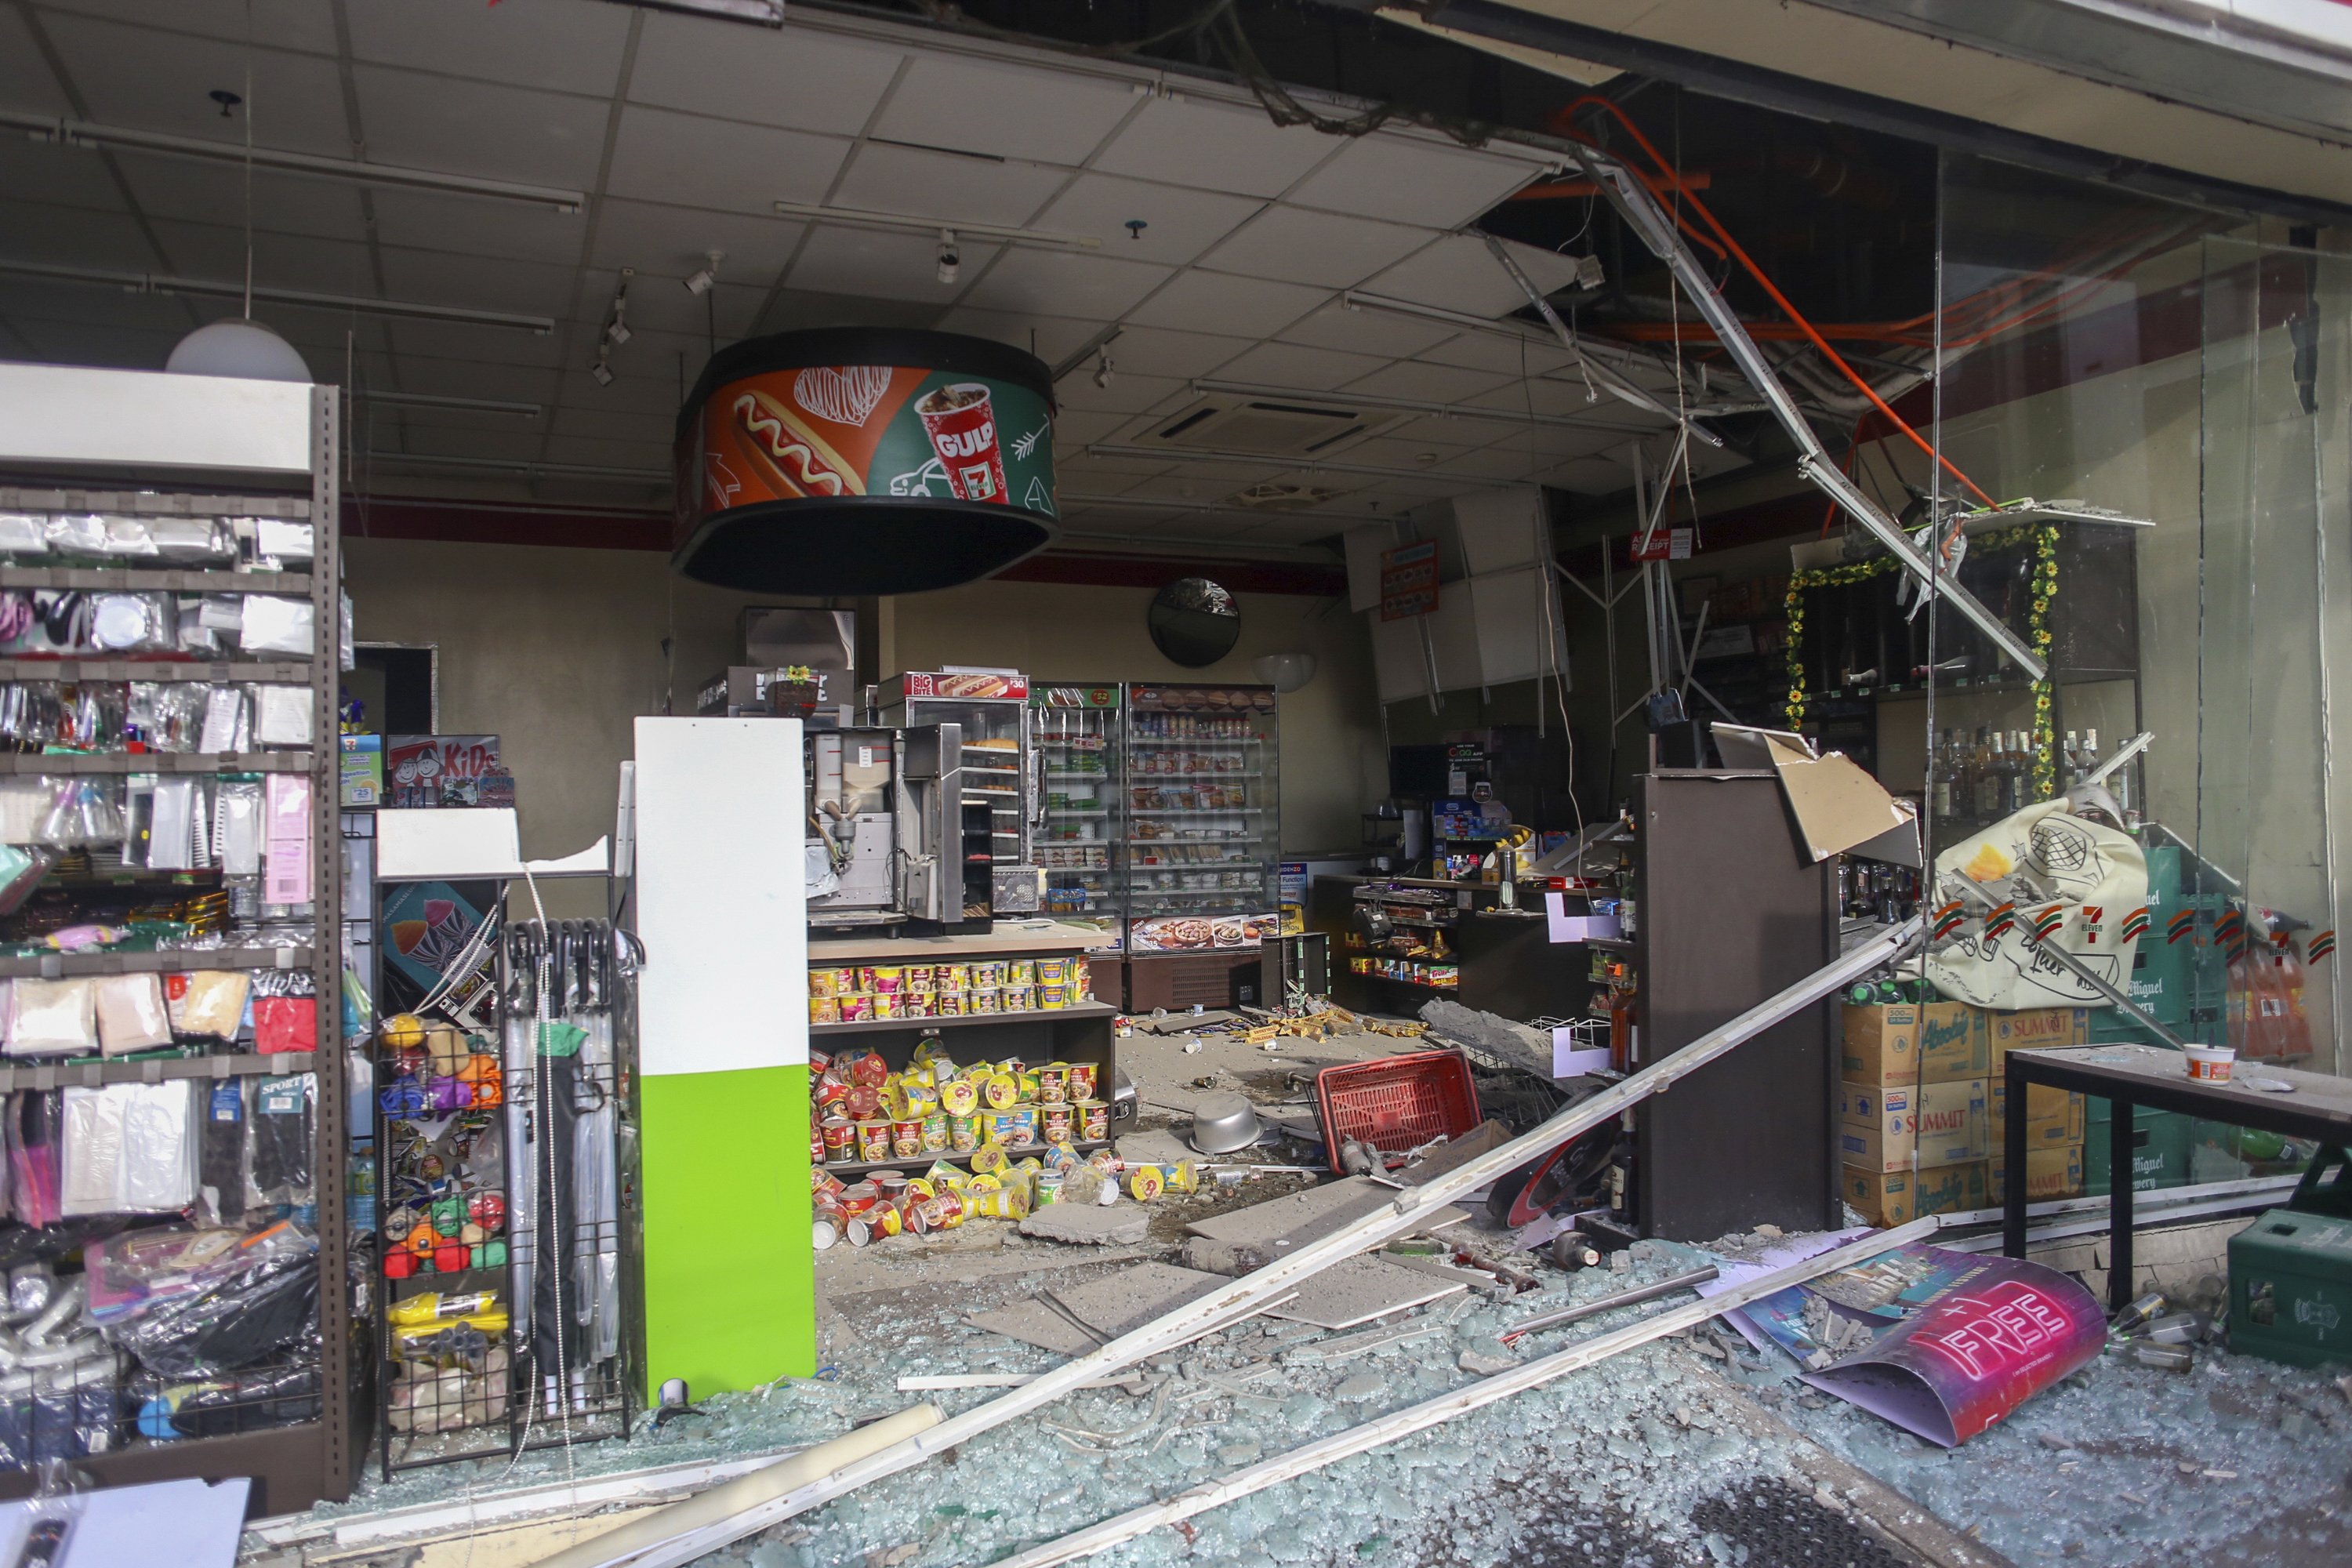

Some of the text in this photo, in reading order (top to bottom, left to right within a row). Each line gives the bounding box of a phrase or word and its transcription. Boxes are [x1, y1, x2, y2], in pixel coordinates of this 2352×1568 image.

[936, 421, 993, 458] GULP
[967, 470, 986, 497] 7
[913, 686, 932, 696] BITE
[1131, 920, 1145, 931] NEW!
[2082, 906, 2103, 943] 7
[2269, 931, 2289, 967] 7
[2128, 978, 2163, 998] Miguel
[262, 1076, 302, 1095] SPORT
[1906, 1109, 1966, 1134] SUMMIT
[2026, 1172, 2064, 1191] MMIT
[1939, 1294, 2066, 1382] FREE
